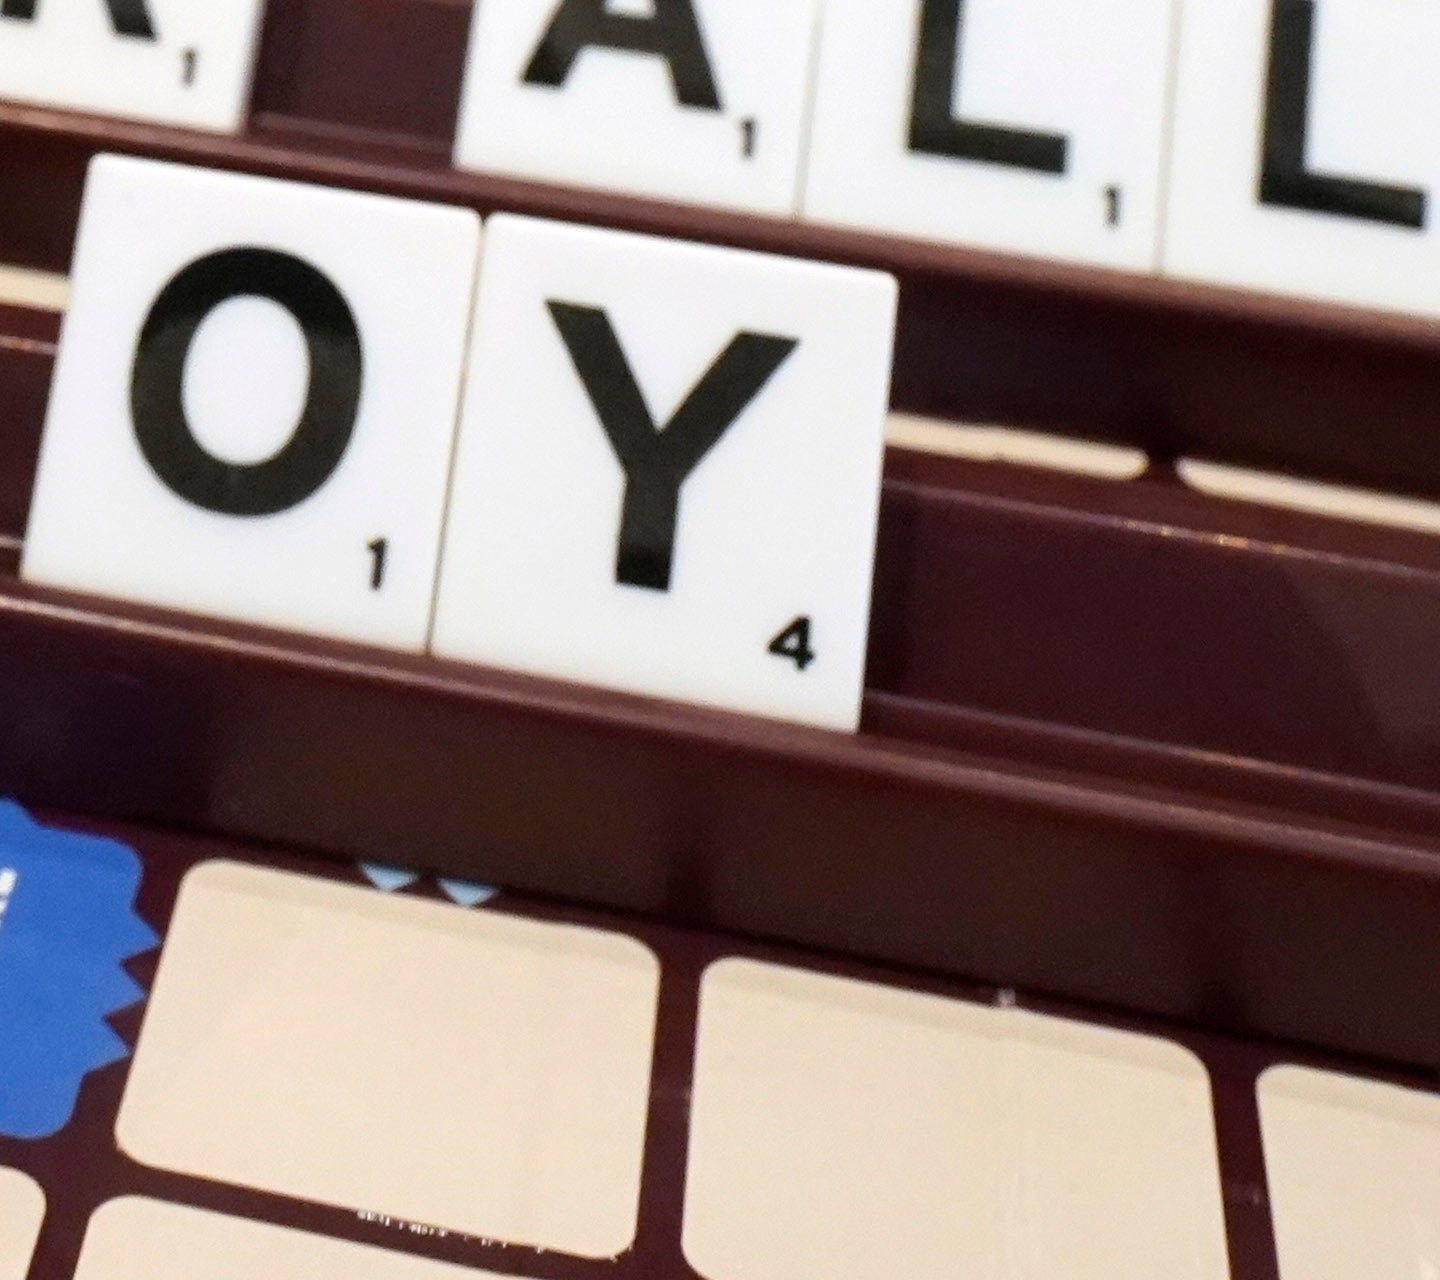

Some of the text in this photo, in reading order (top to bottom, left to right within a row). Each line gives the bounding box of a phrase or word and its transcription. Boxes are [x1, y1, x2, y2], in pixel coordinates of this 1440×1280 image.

[181, 48, 197, 88] 1
[739, 116, 757, 159] 1
[1102, 184, 1120, 226] 1
[130, 246, 800, 592] OY
[367, 537, 389, 590] 1
[767, 616, 815, 671] 4
